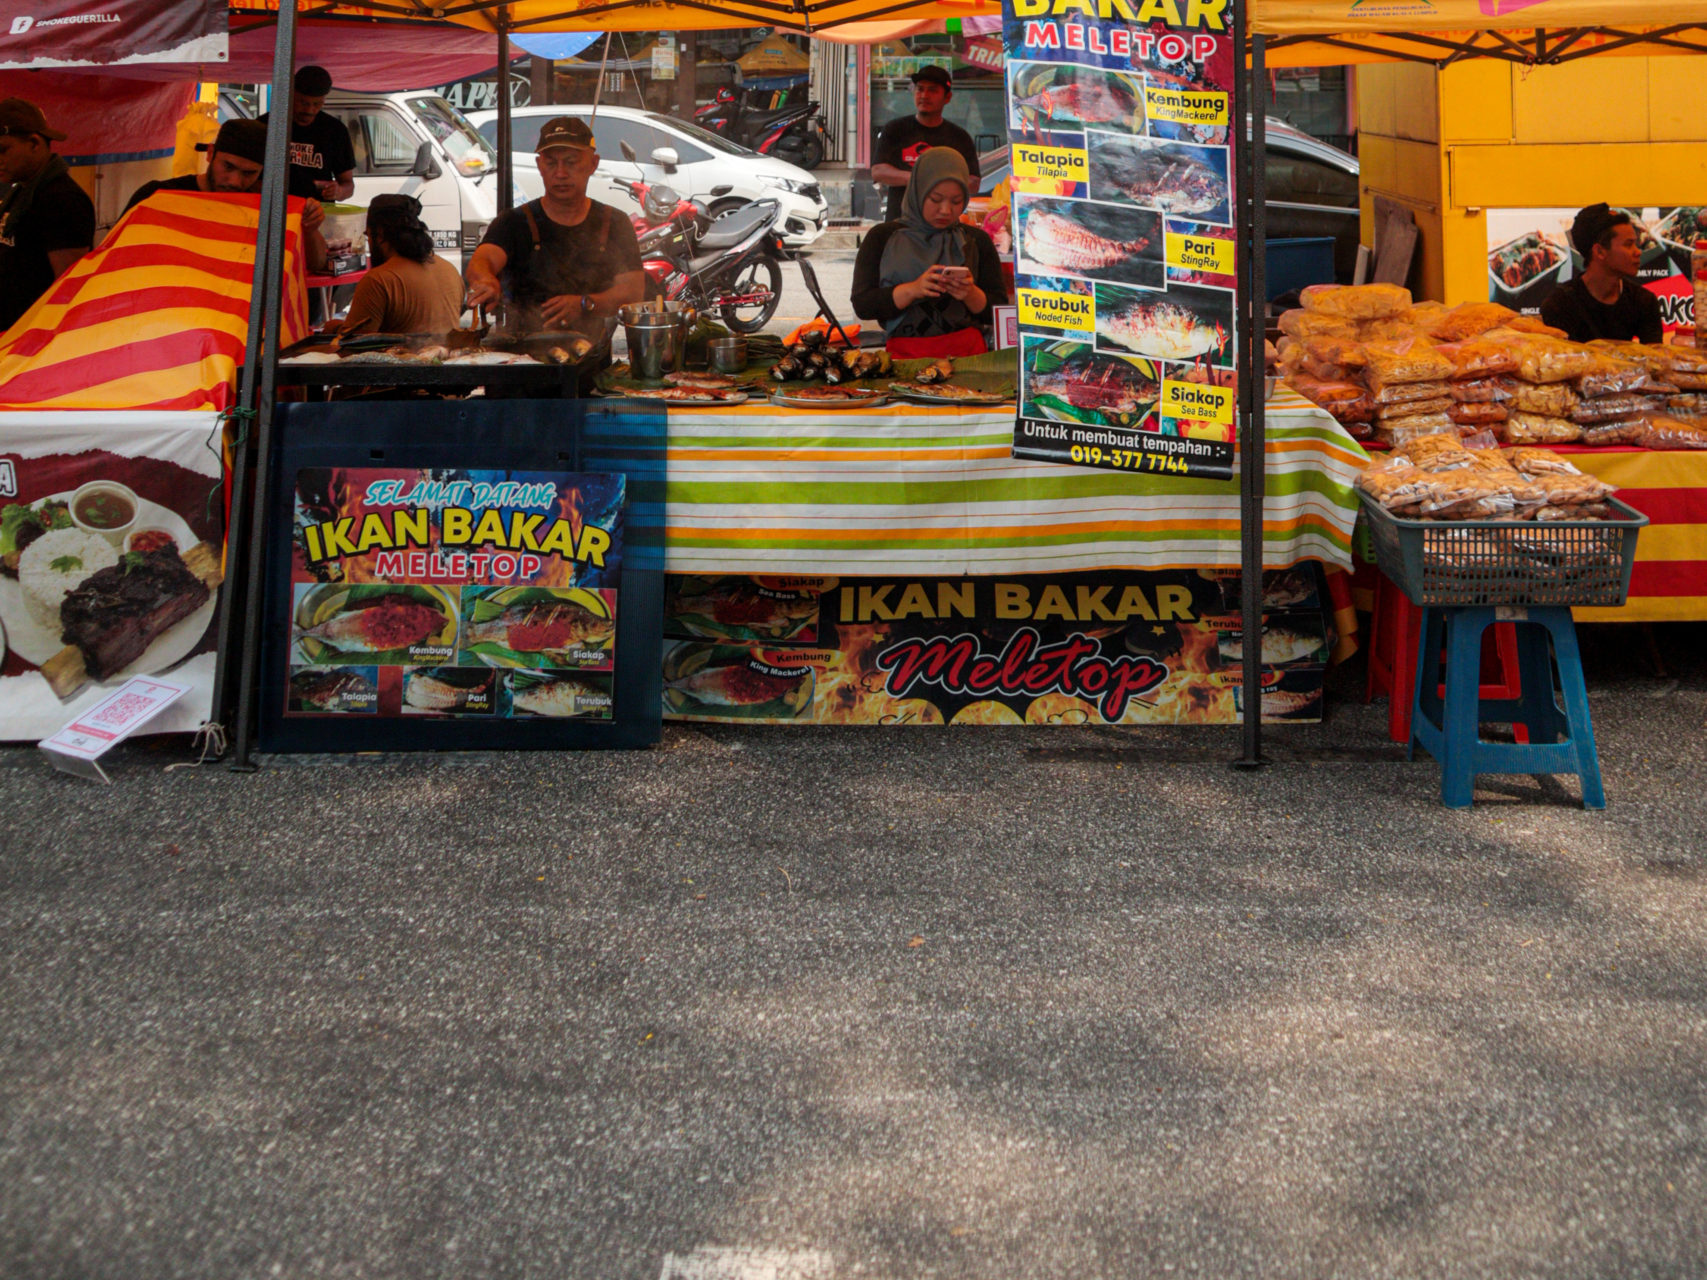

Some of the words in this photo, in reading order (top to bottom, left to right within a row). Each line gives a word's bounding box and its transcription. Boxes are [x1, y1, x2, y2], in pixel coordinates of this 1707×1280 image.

[1025, 21, 1217, 63] MELETOP
[1147, 91, 1225, 111] Kembung
[1156, 107, 1219, 121] KingMackerel
[1019, 150, 1084, 169] Talapia
[1037, 166, 1068, 178] Tilapia
[1184, 239, 1215, 256] Pari
[1180, 253, 1220, 269] StingRay
[1653, 269, 1669, 277] PACK
[1021, 293, 1090, 314] Terubuk
[1520, 307, 1540, 315] SINGLE
[1035, 311, 1062, 324] Noded
[1064, 314, 1083, 326] Fish
[1170, 387, 1225, 409] Siakap
[1181, 405, 1197, 417] Sea
[1198, 407, 1217, 418] Bass
[1024, 421, 1068, 440] Untuk
[1072, 429, 1139, 449] membuat
[1143, 435, 1212, 456] tempahan
[1070, 445, 1142, 468] 019-377
[1147, 454, 1189, 473] 7744
[363, 479, 469, 507] SELAMAT
[470, 482, 558, 510] DATANG
[304, 508, 429, 563] IKAN
[443, 507, 611, 568] BAKAR
[375, 552, 542, 579] MELETOP
[779, 576, 824, 588] Siakap
[758, 588, 774, 597] Sea
[775, 591, 796, 599] Bass
[839, 582, 976, 622] IKAN
[994, 582, 1196, 621] BAKAR
[409, 646, 453, 657] Kembung
[573, 650, 605, 660] Siakap
[776, 652, 831, 663] Kembung
[750, 661, 769, 674] King
[770, 665, 810, 677] Mackerel
[878, 627, 1167, 722] Meletop
[342, 692, 377, 702] Talapia
[468, 694, 487, 702] Pari
[576, 696, 612, 705] Terubuk
